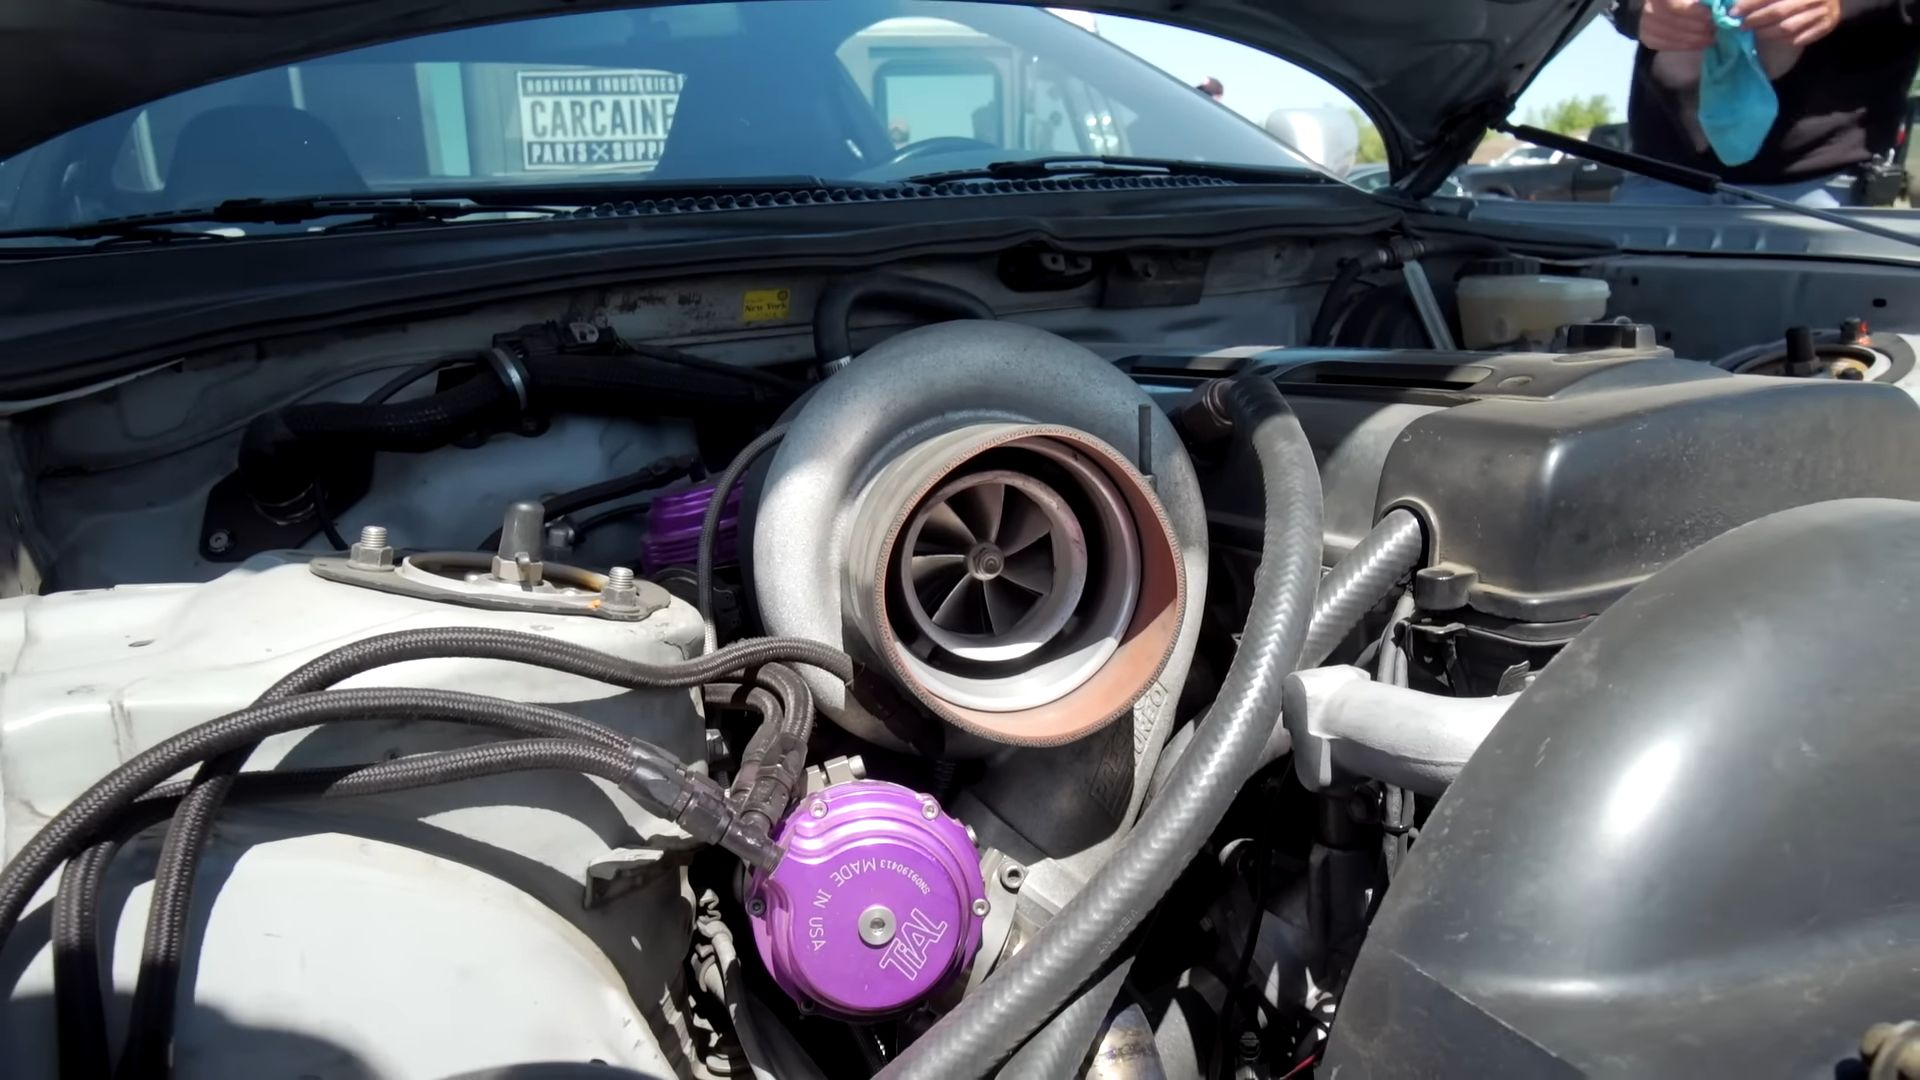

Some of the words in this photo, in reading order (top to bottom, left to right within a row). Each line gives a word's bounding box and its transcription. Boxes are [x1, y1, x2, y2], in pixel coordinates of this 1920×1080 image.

[532, 142, 587, 163] PARTS
[830, 857, 877, 887] MADE
[813, 888, 833, 909] IN
[809, 916, 827, 952] USA
